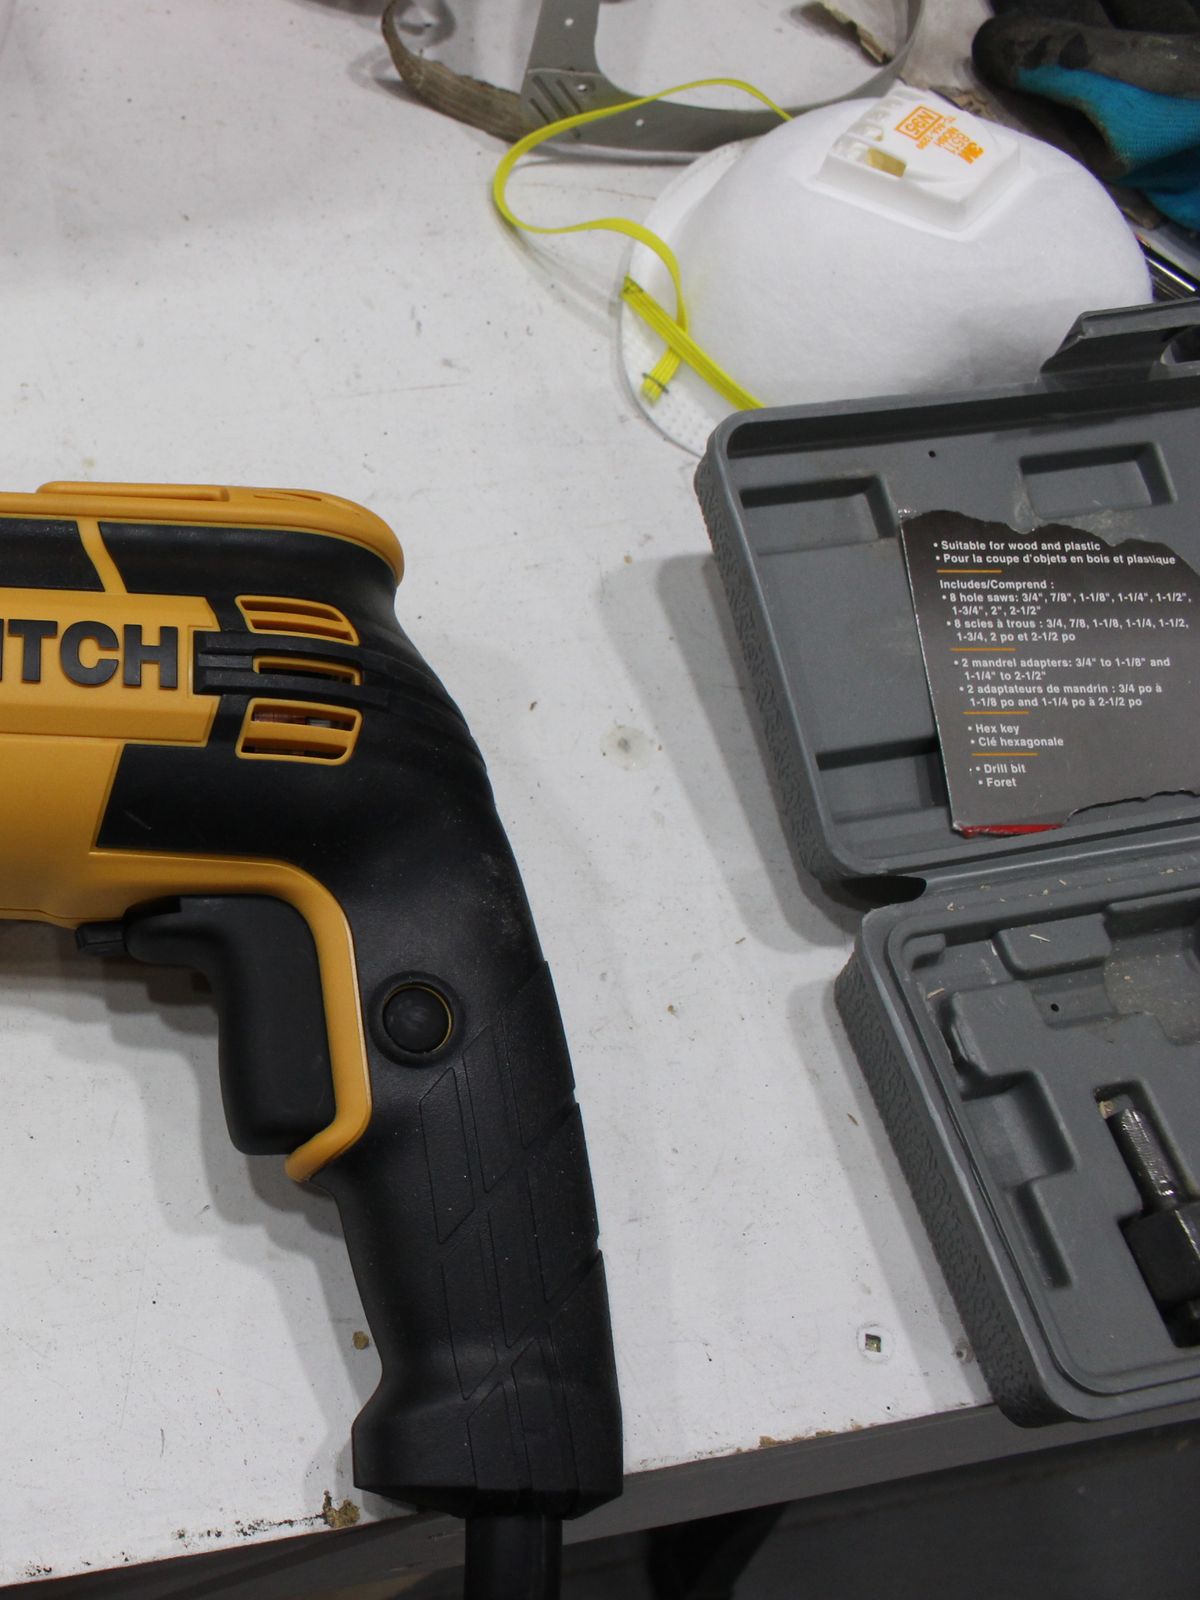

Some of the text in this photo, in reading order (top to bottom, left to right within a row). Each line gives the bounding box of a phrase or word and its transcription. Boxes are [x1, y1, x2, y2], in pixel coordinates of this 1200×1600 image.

[905, 112, 935, 136] N95
[959, 141, 984, 165] 3M
[941, 540, 1101, 552] Suitable for wood and plastic
[943, 553, 969, 563] Pour
[972, 554, 983, 563] la
[986, 556, 1019, 565] coupe
[1023, 554, 1067, 565] d'objets
[1087, 554, 1110, 563] bois
[1113, 555, 1124, 564] et
[1127, 555, 1176, 566] plastique
[940, 580, 1047, 591] Includes/Comprend
[950, 593, 956, 602] 8
[960, 593, 984, 602] hole
[987, 594, 1019, 602] saws:
[954, 619, 961, 628] 8
[964, 619, 993, 628] scies
[997, 619, 1004, 628] à
[1007, 620, 1036, 628] trous
[1046, 619, 1067, 629] 3/4,
[1069, 619, 1090, 630] 7/8,
[1093, 619, 1123, 630] 1-1/8,
[1126, 619, 1156, 630] 1-1/4,
[1159, 619, 1189, 629] 1-1/2,
[957, 632, 1076, 643] 1-3/4, 2 po et 2-1/2 po
[961, 658, 969, 667] 2
[972, 658, 1017, 667] mandrel
[1020, 658, 1072, 669] adapters:
[1100, 658, 1112, 667] to
[1150, 657, 1171, 667] and
[1000, 671, 1012, 680] to
[967, 684, 974, 694] 2
[977, 684, 1043, 695] adaptateurs
[1046, 684, 1060, 693] de
[1063, 684, 1109, 693] mandrin
[1118, 684, 1135, 693] 3/4
[1138, 685, 1152, 695] po
[1155, 683, 1162, 693] à
[970, 697, 1143, 709] 1-1/8 po and 1-1/4 po à 2-1/2 po
[975, 723, 1020, 735] Hex key
[978, 737, 1064, 749] Clé hexagonale
[984, 764, 1026, 773] Drill bit
[986, 777, 1017, 787] Foret
